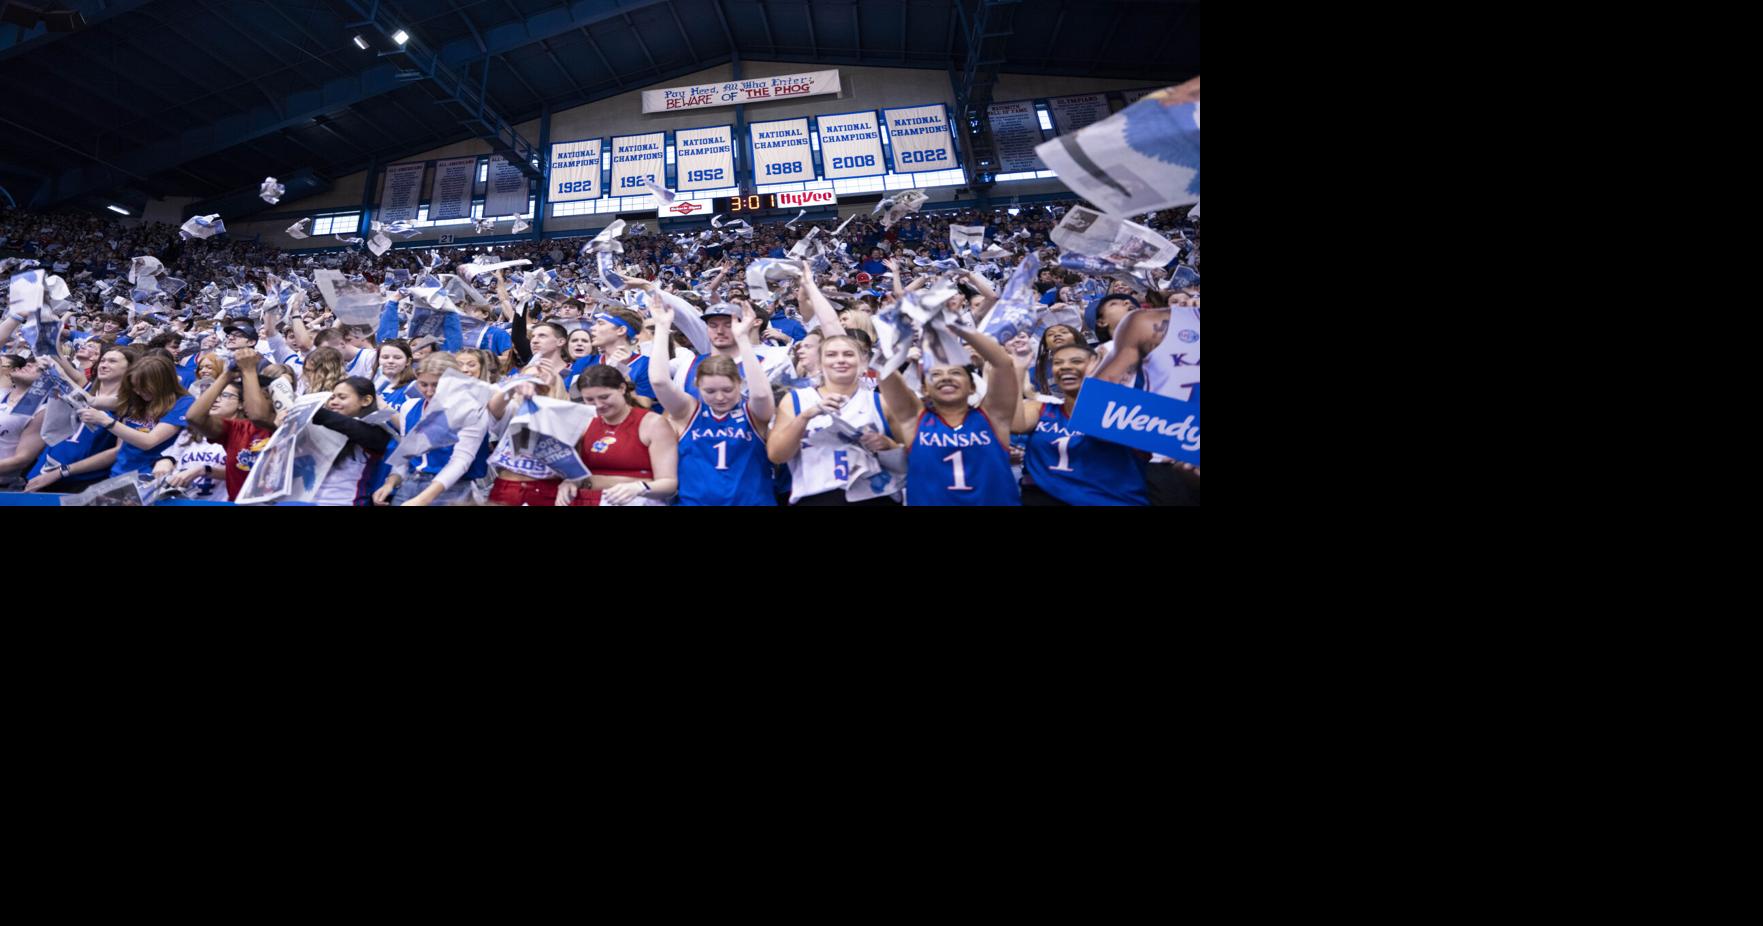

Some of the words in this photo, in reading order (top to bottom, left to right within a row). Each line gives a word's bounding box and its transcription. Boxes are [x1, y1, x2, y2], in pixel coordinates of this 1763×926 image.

[665, 90, 685, 99] Pay
[690, 86, 719, 96] Heed,
[723, 83, 738, 91] All
[666, 94, 712, 109] BEWARE
[721, 92, 738, 101] OF
[826, 122, 872, 133] NATIONAL
[894, 115, 941, 127] NATIONAL
[759, 129, 802, 139] NATIONAL
[891, 124, 948, 137] CHAMPIONS
[683, 136, 725, 147] NATIONAL
[754, 138, 808, 150] CHAMPIONS
[822, 132, 878, 144] CHAMPIONS
[557, 149, 596, 159] NATIONAL
[619, 143, 659, 153] NATIONAL
[678, 145, 730, 157] CHAMPIONS
[552, 158, 599, 169] CHAMPIONS
[613, 152, 663, 163] CHAMPIONS
[832, 155, 875, 169] 2008
[902, 149, 947, 164] 2022
[687, 168, 723, 182] 1952
[765, 161, 802, 176] 1988
[558, 180, 592, 194] 1922
[691, 427, 752, 441] KANSAS
[919, 430, 991, 448] KANSAS
[181, 451, 226, 465] KANSAS
[712, 441, 729, 470] 1
[1049, 436, 1073, 471] 1
[943, 450, 973, 490] 1
